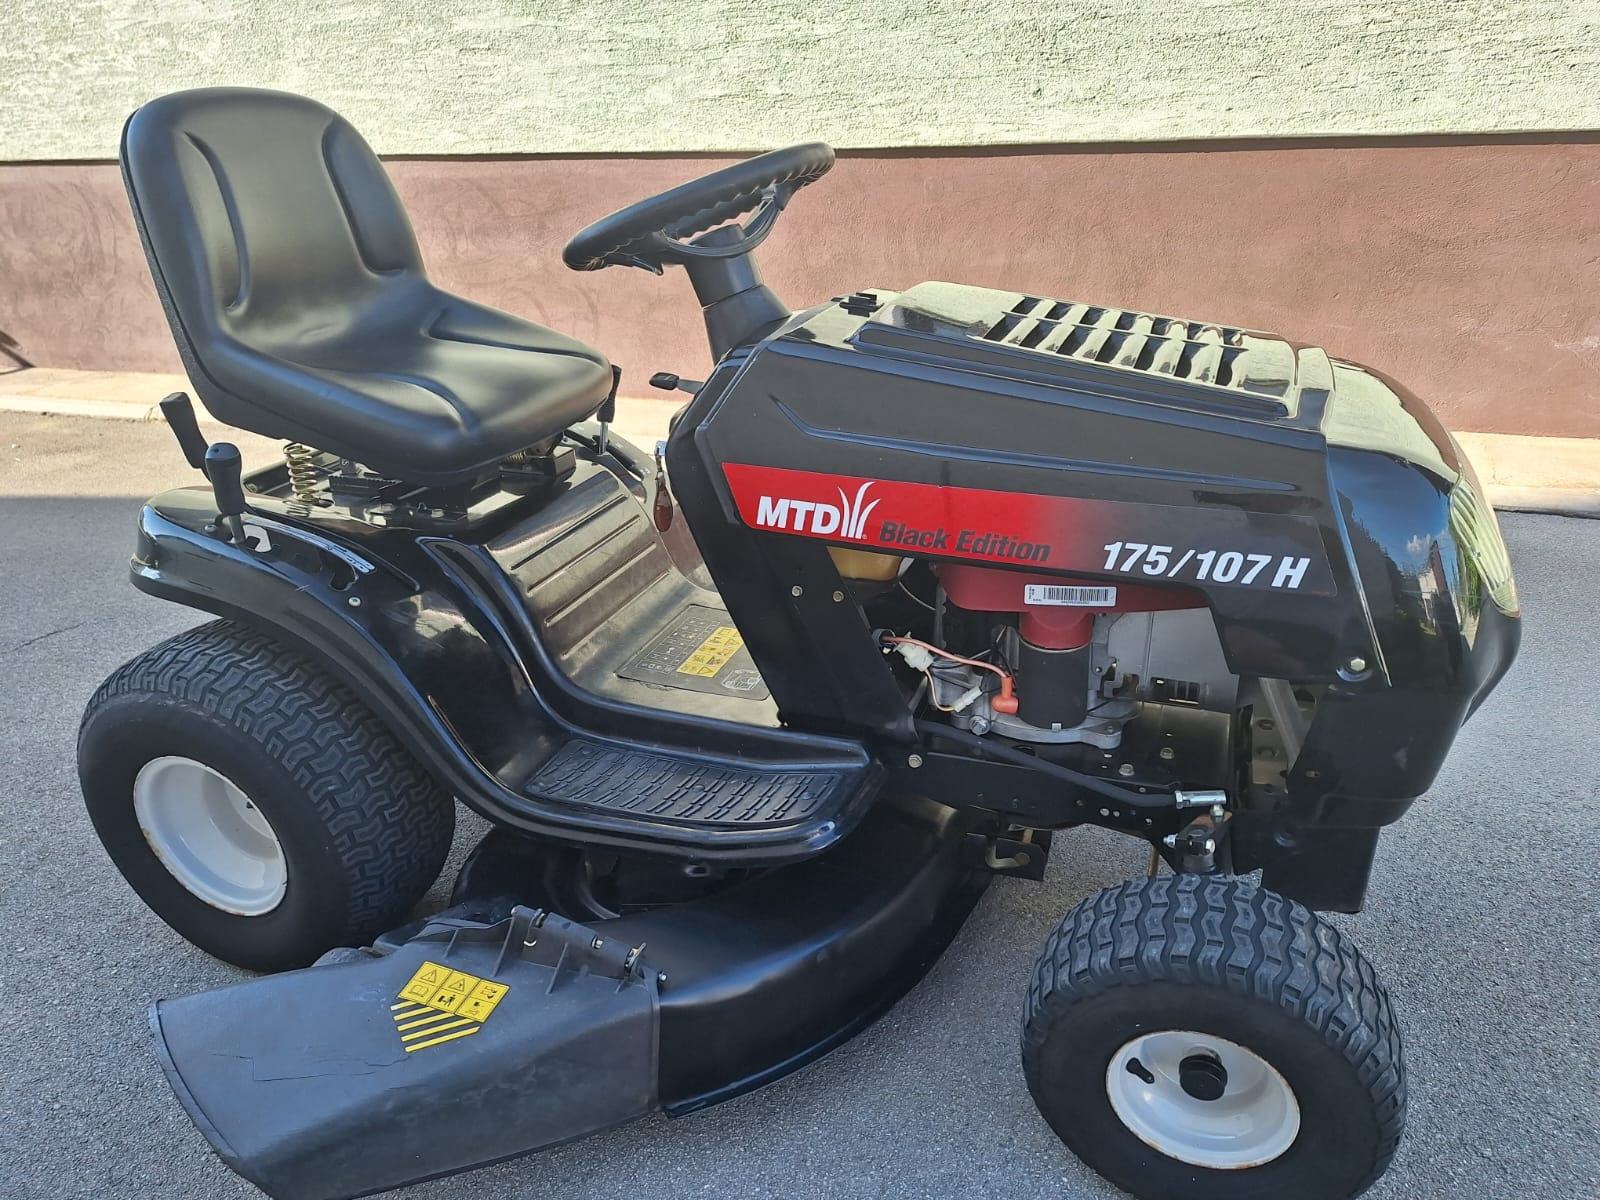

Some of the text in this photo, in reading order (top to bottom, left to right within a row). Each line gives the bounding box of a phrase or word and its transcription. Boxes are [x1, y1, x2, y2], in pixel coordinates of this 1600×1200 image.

[756, 495, 841, 534] MTD
[879, 520, 1052, 561] Black Edition
[1103, 541, 1311, 589] 175/107 H
